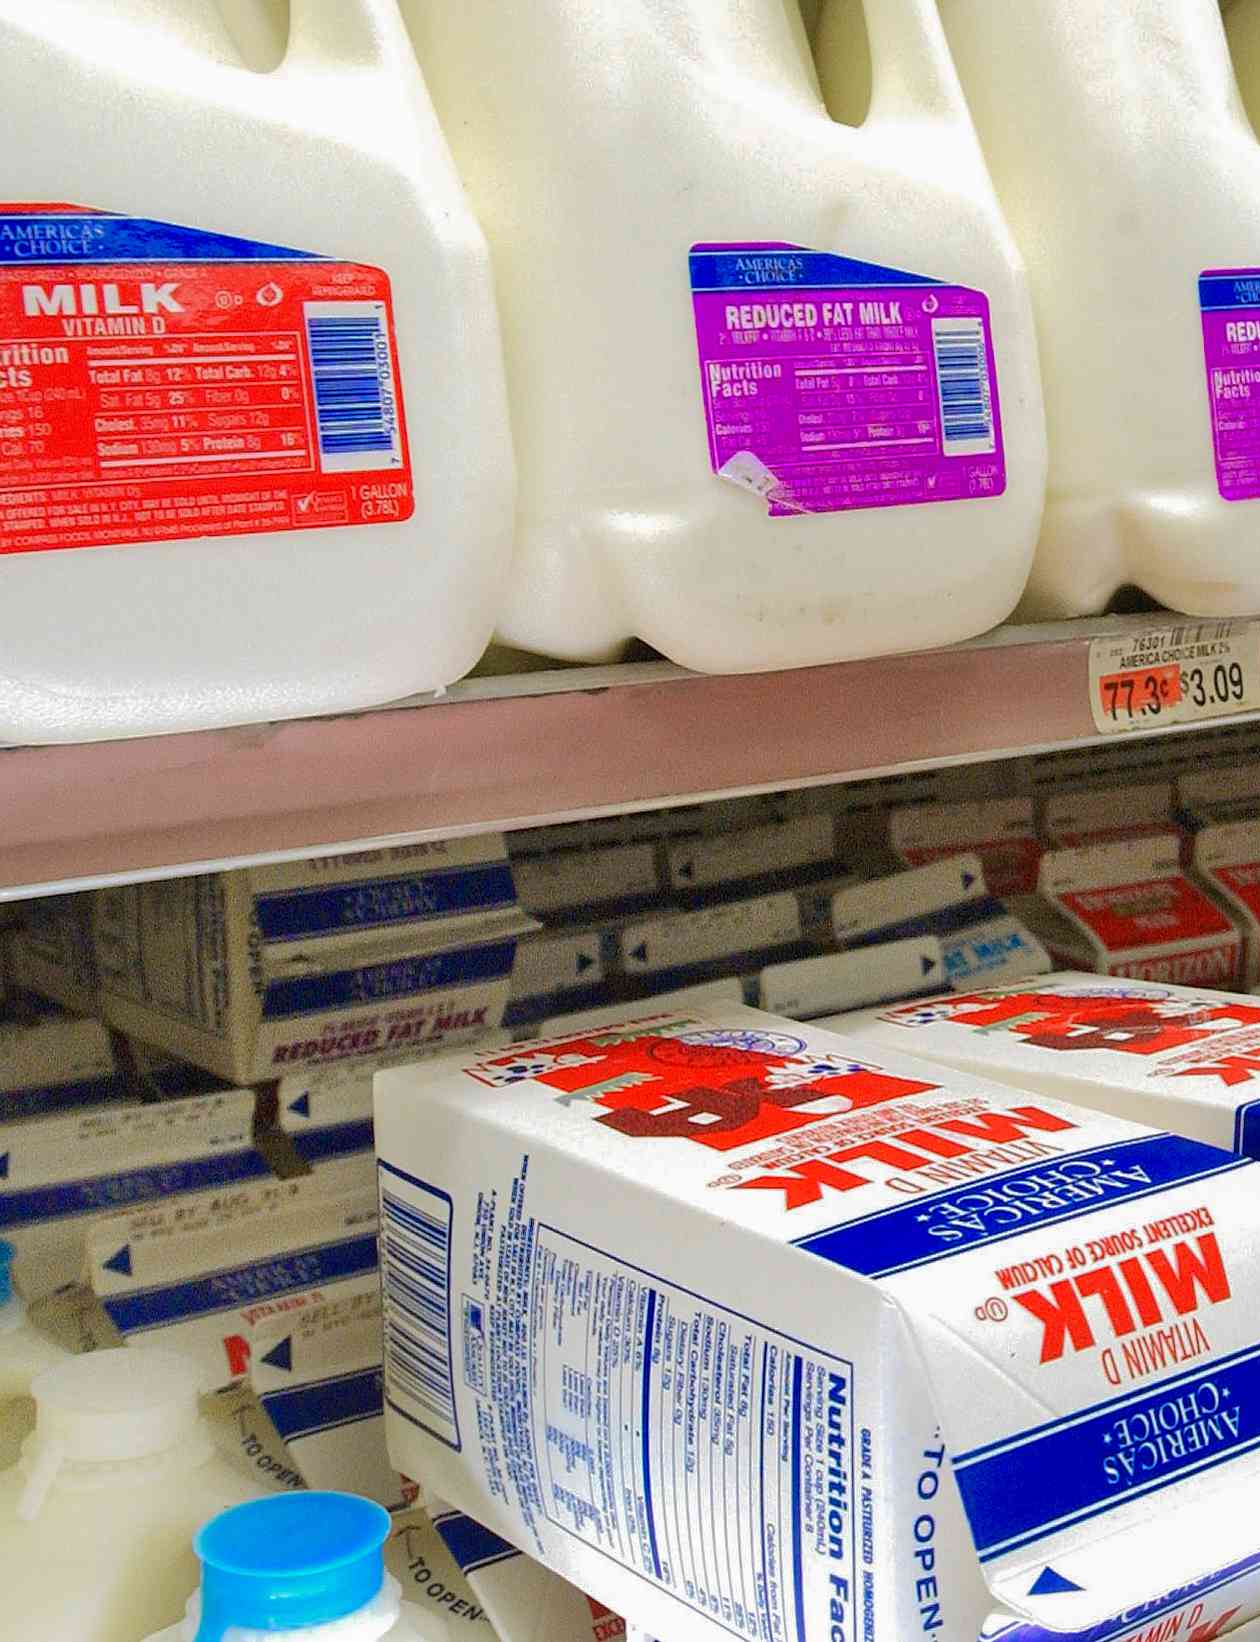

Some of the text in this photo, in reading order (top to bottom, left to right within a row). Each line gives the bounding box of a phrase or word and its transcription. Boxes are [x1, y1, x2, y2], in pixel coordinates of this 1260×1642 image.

[14, 239, 93, 257] CHOICE
[21, 282, 186, 317] MILK
[744, 270, 795, 284] CHOICE
[62, 316, 166, 337] VITAMIN D
[725, 301, 903, 331] REDUCED FAT MILK
[0, 344, 70, 365] rition
[0, 367, 33, 389] cts
[88, 366, 225, 385] Total Fat Total
[708, 361, 782, 382] Nutrition
[710, 378, 759, 398] Facts
[1215, 383, 1252, 400] Facts
[202, 435, 246, 450] Protein
[360, 482, 408, 501] GALLON
[1119, 652, 1161, 669] AMERICA
[1161, 647, 1195, 664] CHOICE
[1179, 662, 1244, 707] $3.09
[732, 1105, 1080, 1211] MILK
[886, 1139, 1063, 1195] VITAMIN D
[928, 1159, 1101, 1218] CHOICE
[928, 1165, 1154, 1243] AMERICA'S
[994, 1206, 1216, 1291] EXCELLENT SOURCE OF CALCIUM
[637, 1286, 648, 1334] Vitamin
[654, 1293, 666, 1344] Protein
[1012, 1232, 1232, 1365] MILK
[664, 1315, 676, 1362] Sugars
[676, 1321, 688, 1370] Dietary
[1102, 1317, 1211, 1386] VITAMIN D
[698, 1316, 715, 1421] Sodium 130mg
[714, 1321, 727, 1406] Cholesterol
[726, 1344, 738, 1409] Saturated
[738, 1333, 753, 1417] Total Fat 8g
[767, 1345, 778, 1406] Calories
[675, 1372, 685, 1406] Fiber
[684, 1311, 702, 1474] Total Carbohydrate 12g
[815, 1365, 827, 1421] Serving
[726, 1413, 736, 1436] Fat
[766, 1410, 776, 1436] 150
[1108, 1381, 1220, 1447] CHOICE
[803, 1360, 816, 1521] Servings Per Container
[815, 1423, 826, 1454] Size
[1104, 1405, 1241, 1486] AMERICA'S
[256, 1454, 306, 1489] OPEN
[814, 1469, 825, 1495] cup
[827, 1373, 849, 1642] Nutrition Fac
[861, 1486, 874, 1565] PASTEURIZED
[766, 1523, 777, 1577] Calories
[913, 1443, 946, 1633] TO OPEN
[408, 1555, 484, 1622] TO OPEN
[768, 1580, 779, 1610] from
